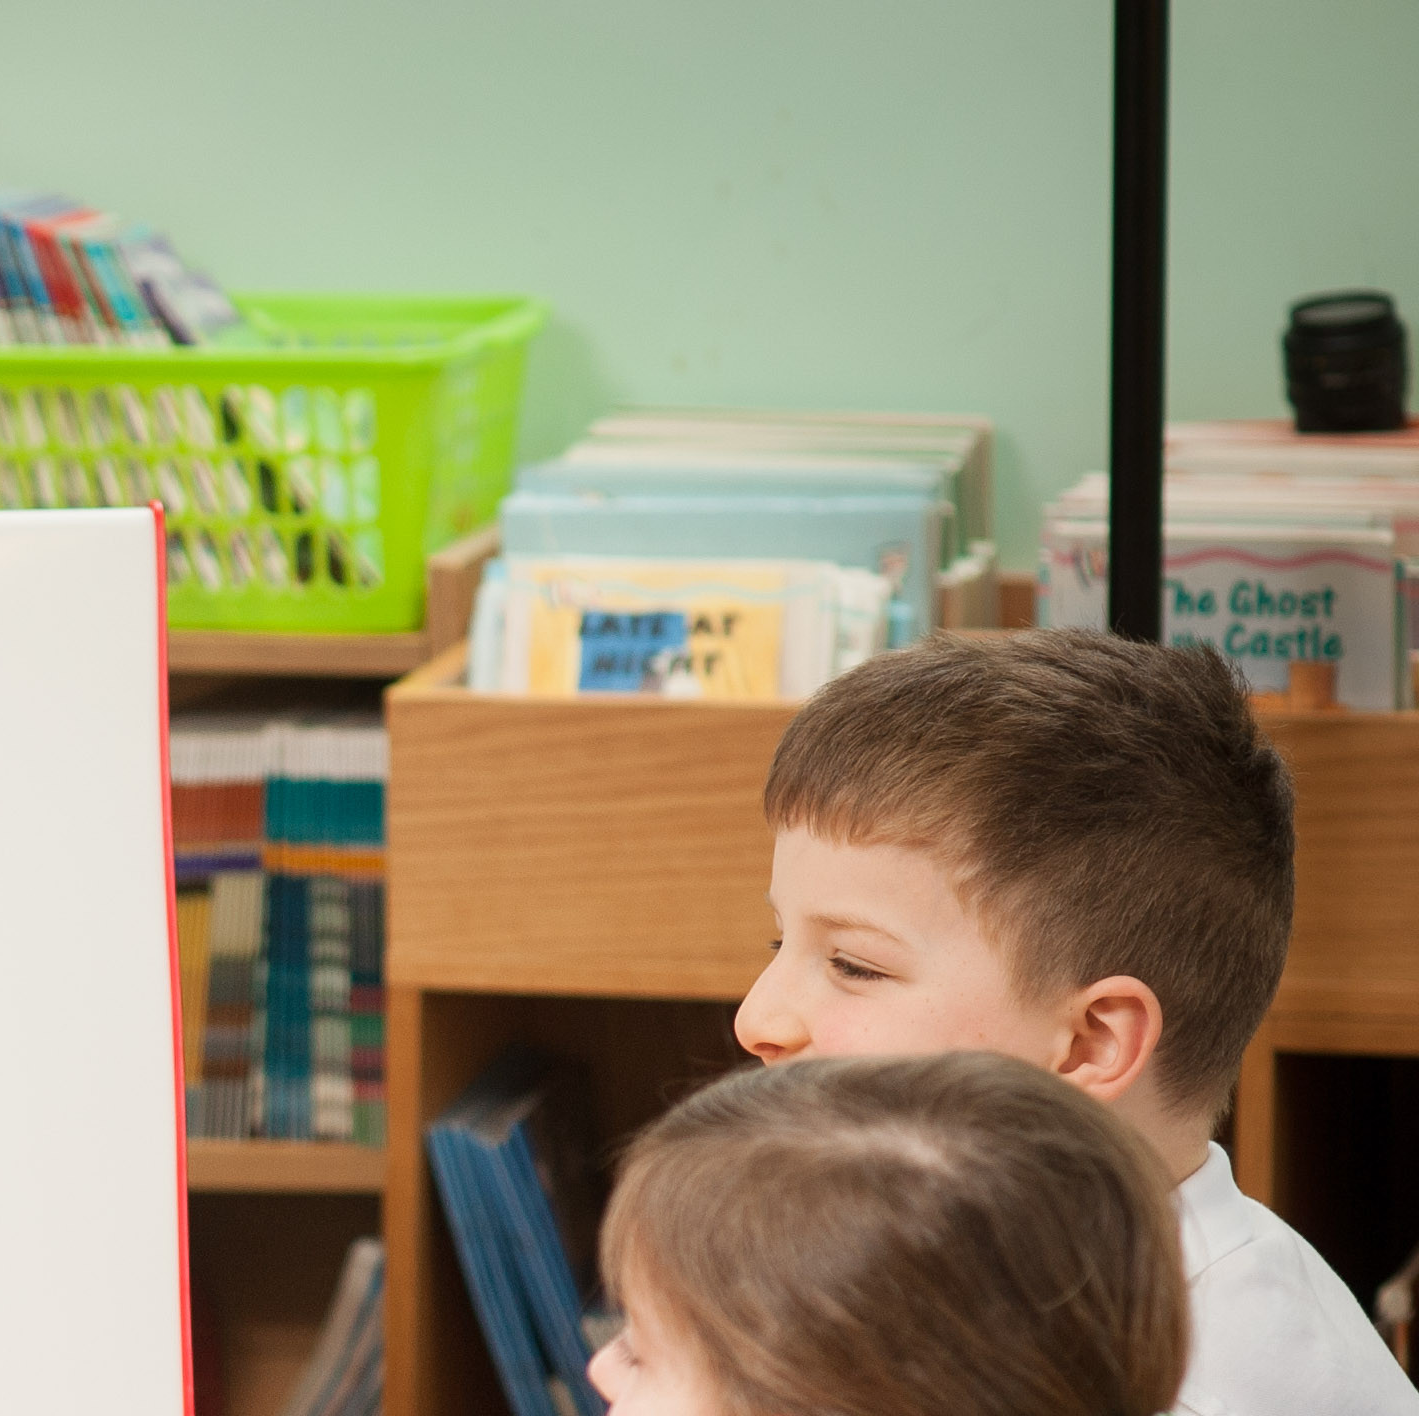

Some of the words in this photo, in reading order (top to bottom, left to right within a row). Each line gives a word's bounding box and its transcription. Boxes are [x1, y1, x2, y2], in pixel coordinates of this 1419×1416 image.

[1229, 579, 1336, 617] Ghost
[691, 611, 739, 637] AT
[1224, 623, 1343, 659] Castle
